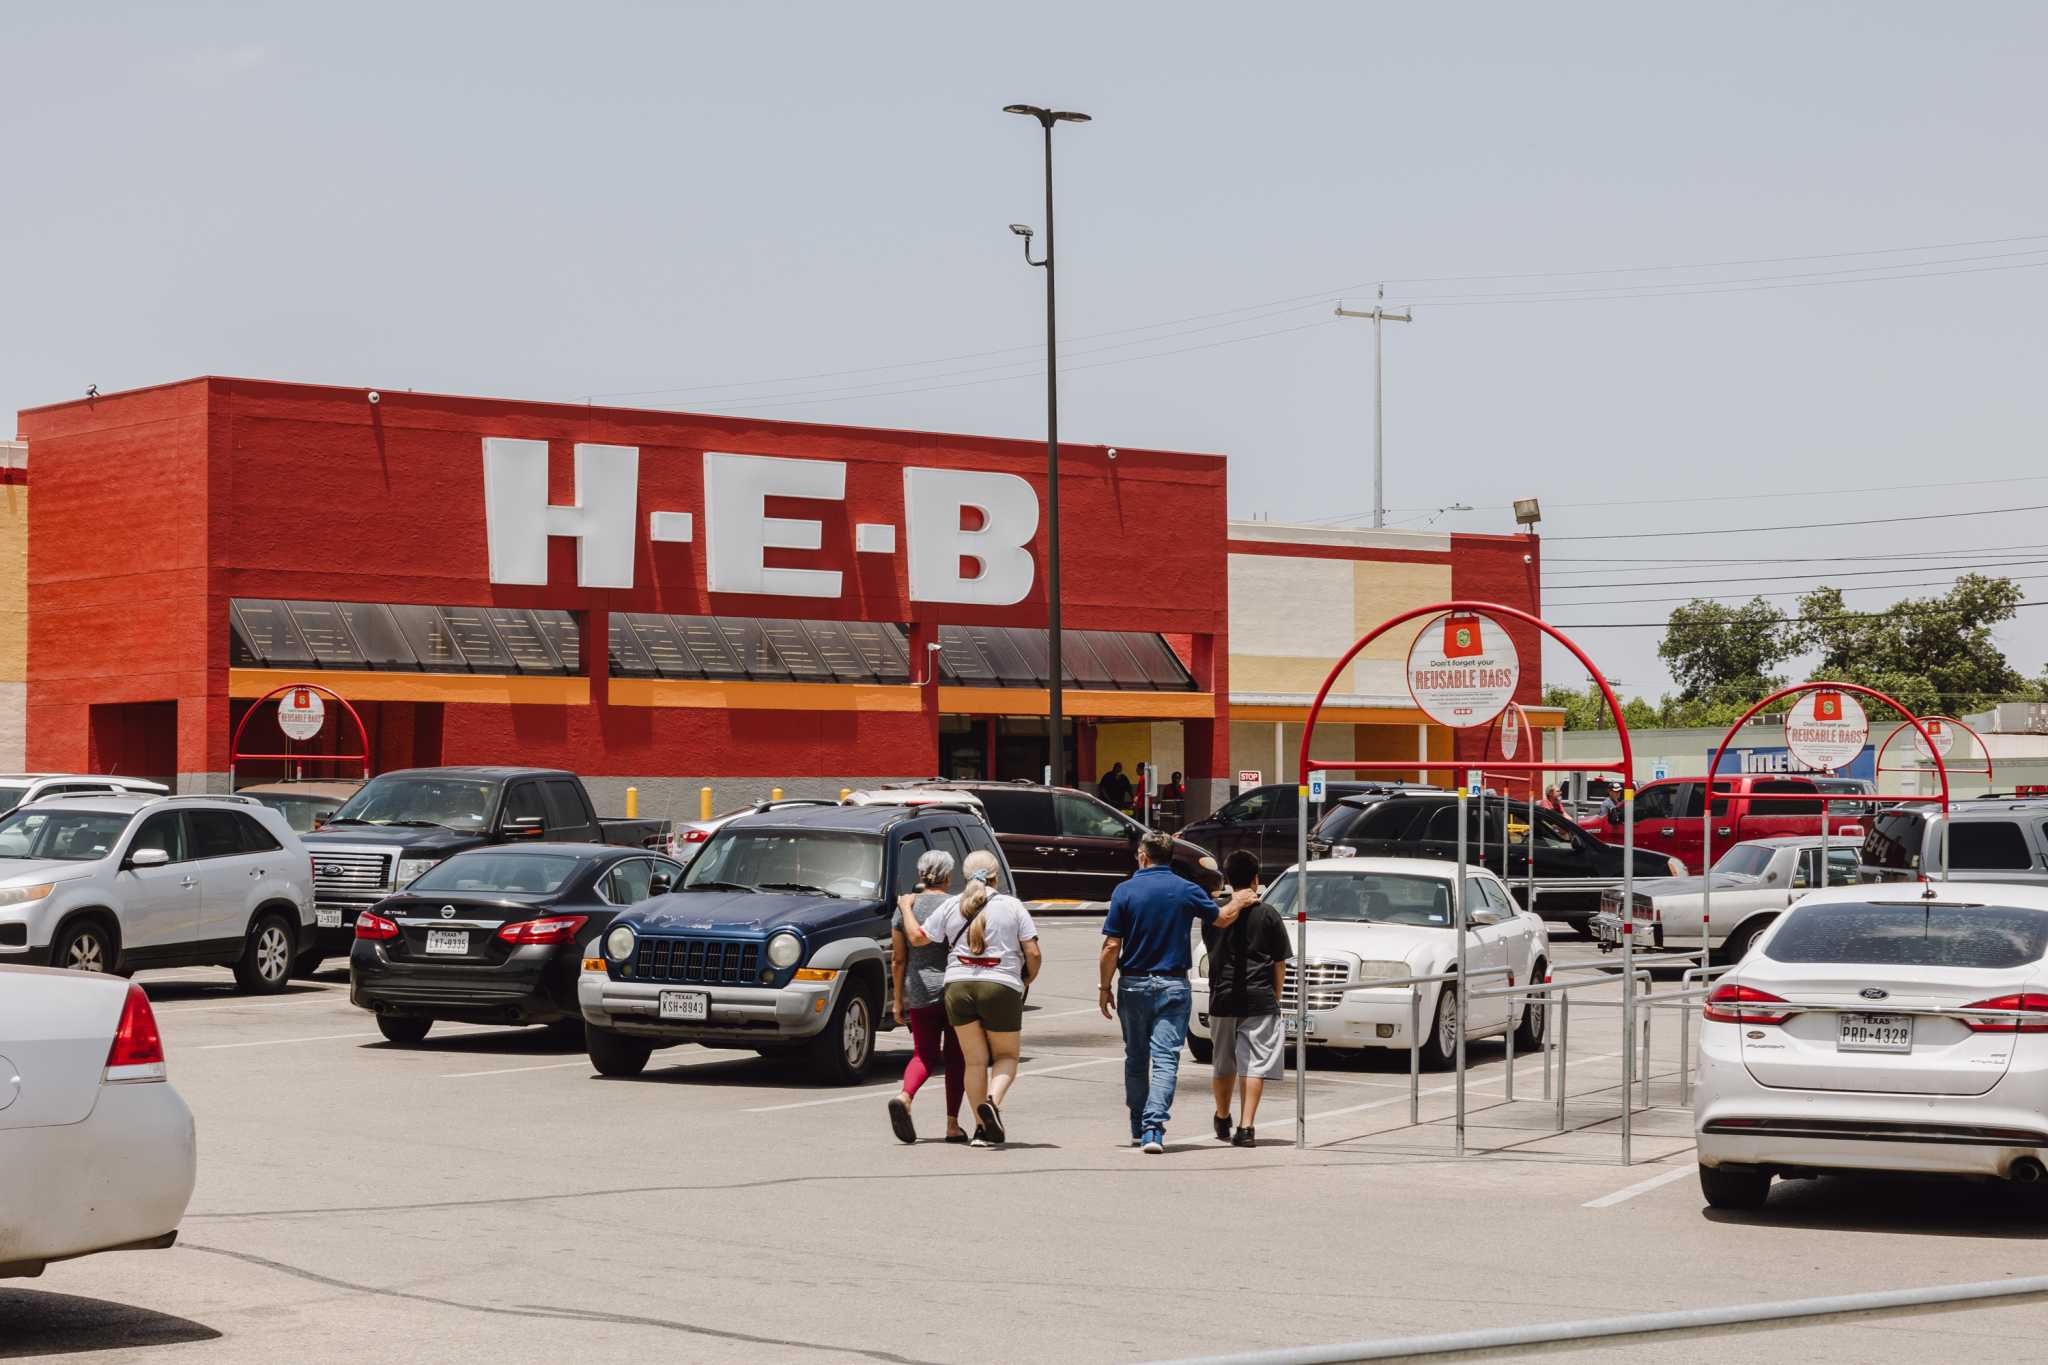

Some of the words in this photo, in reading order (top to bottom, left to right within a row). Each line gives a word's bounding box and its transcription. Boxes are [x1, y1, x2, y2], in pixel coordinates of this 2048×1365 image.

[1415, 669, 1477, 689] REUSABLE
[1479, 668, 1512, 688] BAGS
[1792, 728, 1837, 743] REUSABLE
[1838, 730, 1862, 744] BAGS
[1240, 772, 1258, 781] STOP
[1863, 1017, 1890, 1025] TEXAS
